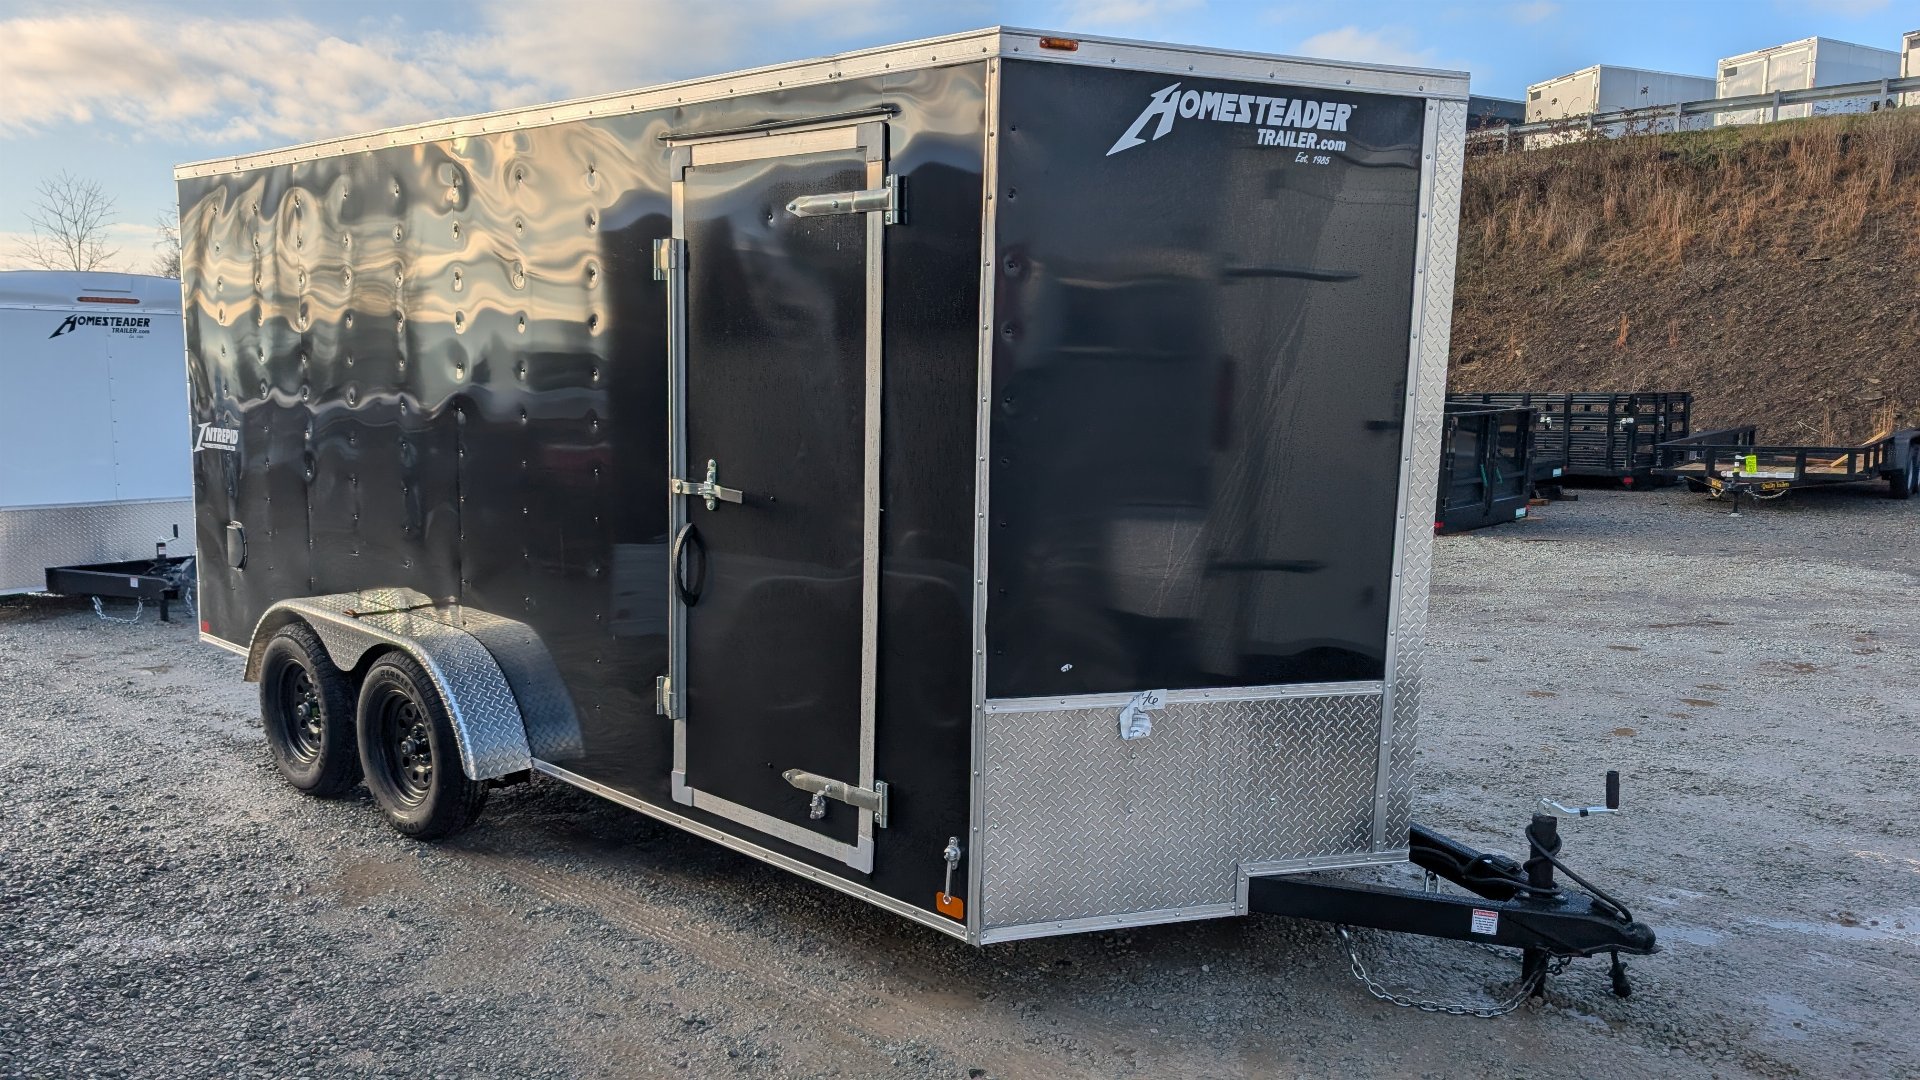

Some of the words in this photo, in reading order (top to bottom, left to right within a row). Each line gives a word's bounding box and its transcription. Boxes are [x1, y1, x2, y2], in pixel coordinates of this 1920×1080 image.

[1106, 82, 1352, 157] HOMESTEADER
[1257, 129, 1346, 152] TRAILER.com
[1312, 155, 1332, 165] 1985
[48, 313, 151, 340] HOMESTEADER
